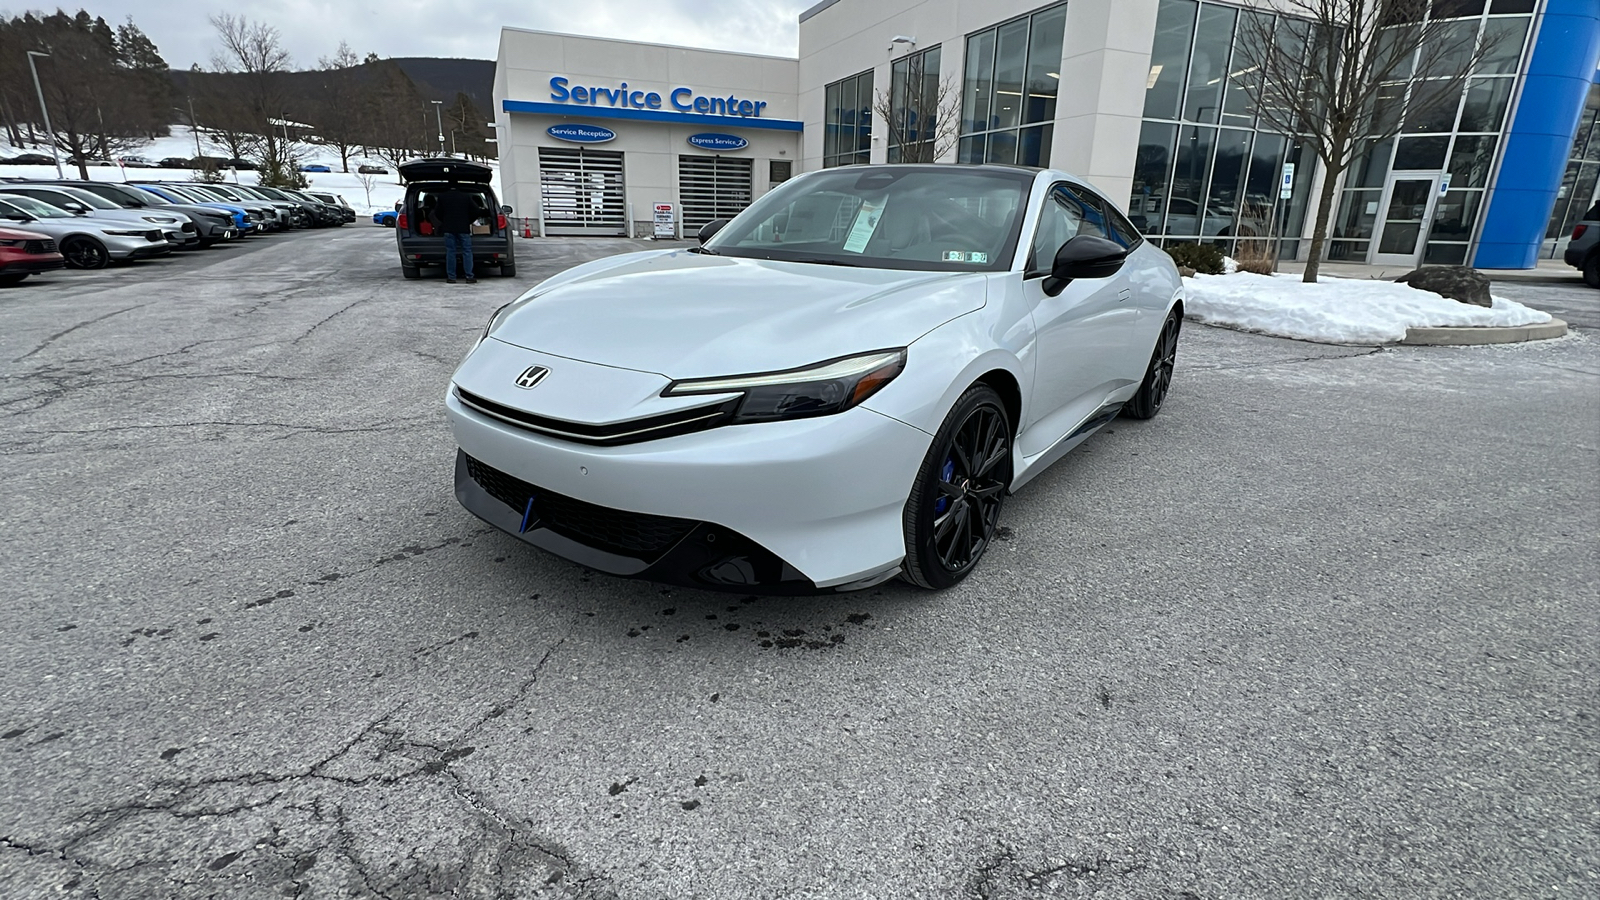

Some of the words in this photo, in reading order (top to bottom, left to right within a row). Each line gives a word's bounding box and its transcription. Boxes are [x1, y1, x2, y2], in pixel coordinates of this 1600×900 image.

[550, 76, 662, 109] Service
[670, 87, 767, 118] Center
[551, 127, 577, 136] Service
[578, 129, 612, 138] Reception
[691, 136, 714, 145] Express
